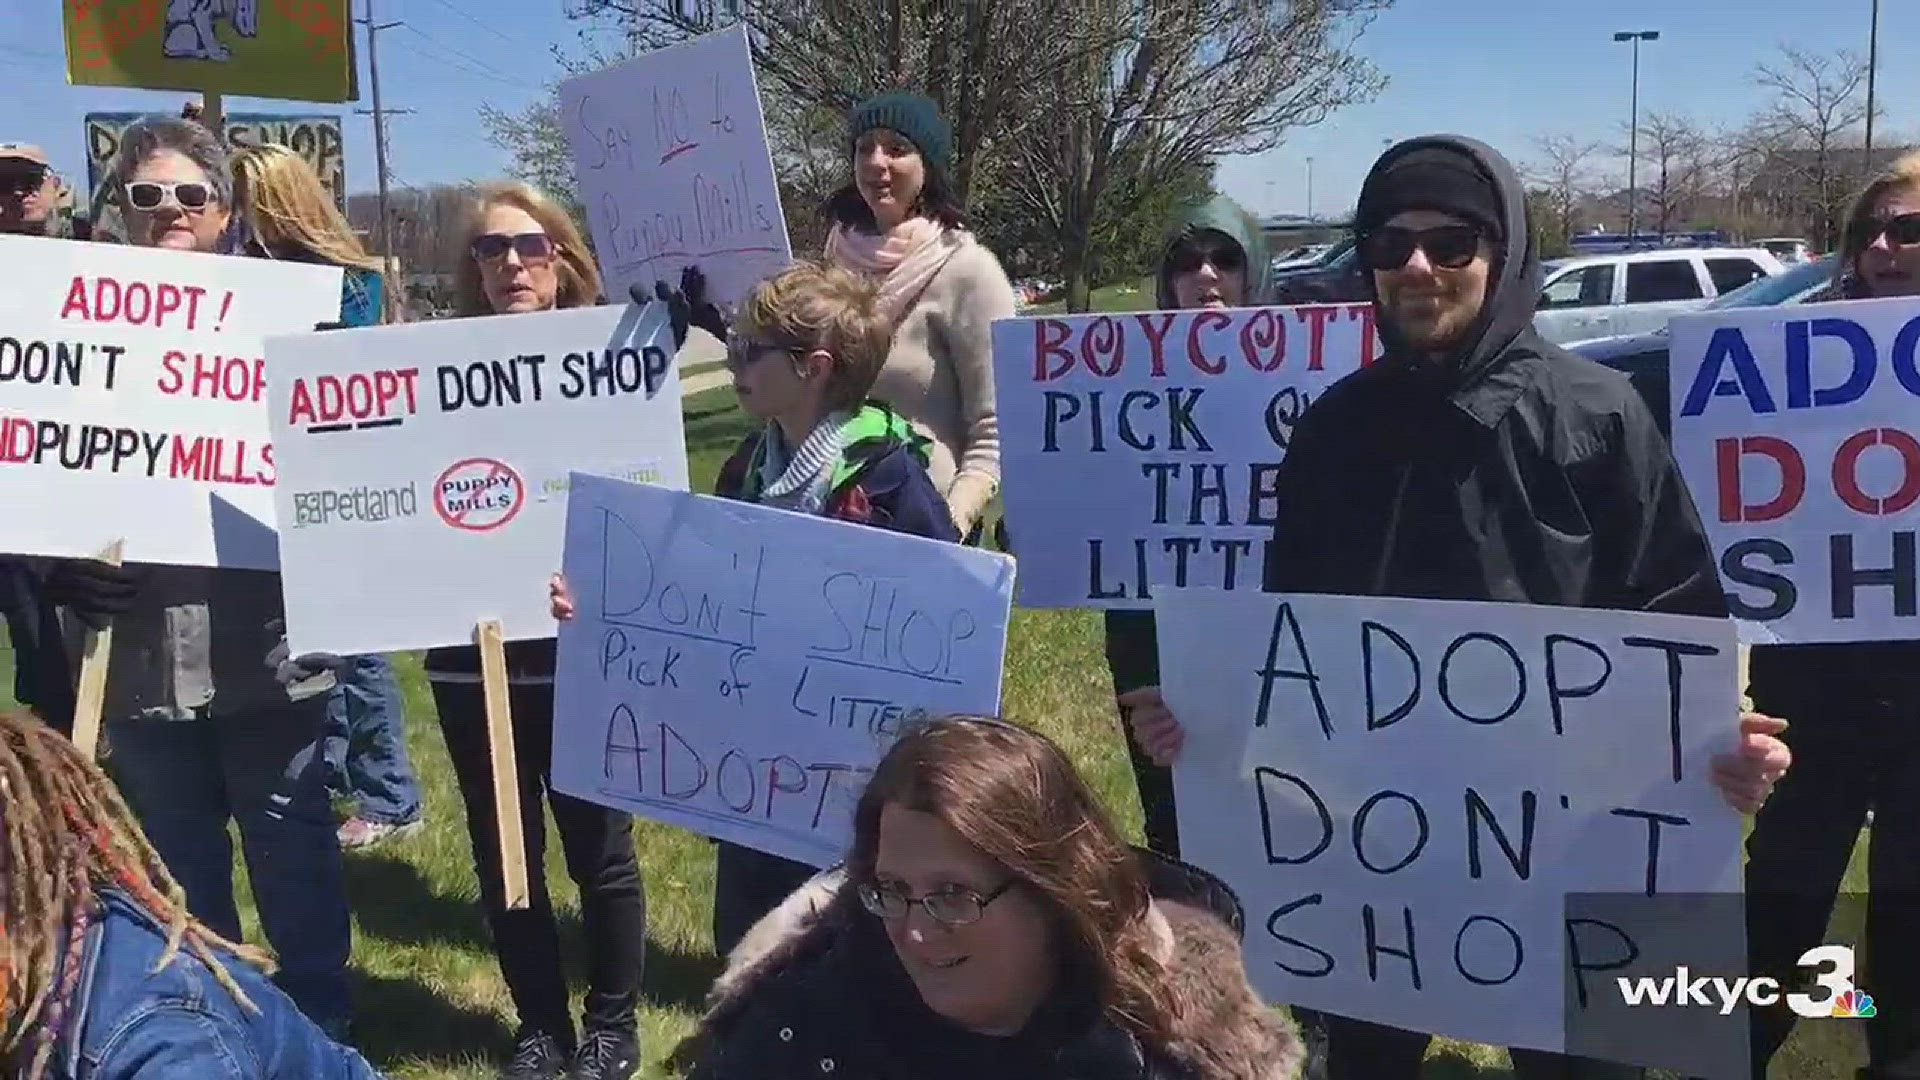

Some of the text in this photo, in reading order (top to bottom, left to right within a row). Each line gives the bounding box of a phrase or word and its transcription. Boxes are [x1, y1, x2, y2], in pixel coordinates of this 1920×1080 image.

[711, 71, 734, 135] to
[694, 161, 773, 246] Mills
[0, 337, 125, 389] DON'T
[1033, 306, 1376, 381] BOYCOTT
[289, 346, 667, 424] ADOPT DON'T SHOP
[1042, 388, 1213, 452] PICK
[322, 481, 416, 523] Petland
[442, 475, 511, 494] PUPPY
[448, 494, 511, 512] MILLS
[1142, 463, 1281, 526] THE
[1087, 538, 1267, 600] LITT
[811, 572, 976, 676] SHOP
[720, 647, 757, 706] of
[1255, 602, 1719, 783] ADOPT
[604, 702, 853, 830] ADOPT
[1255, 766, 1690, 897] DON'T
[1266, 895, 1640, 1008] SHOP
